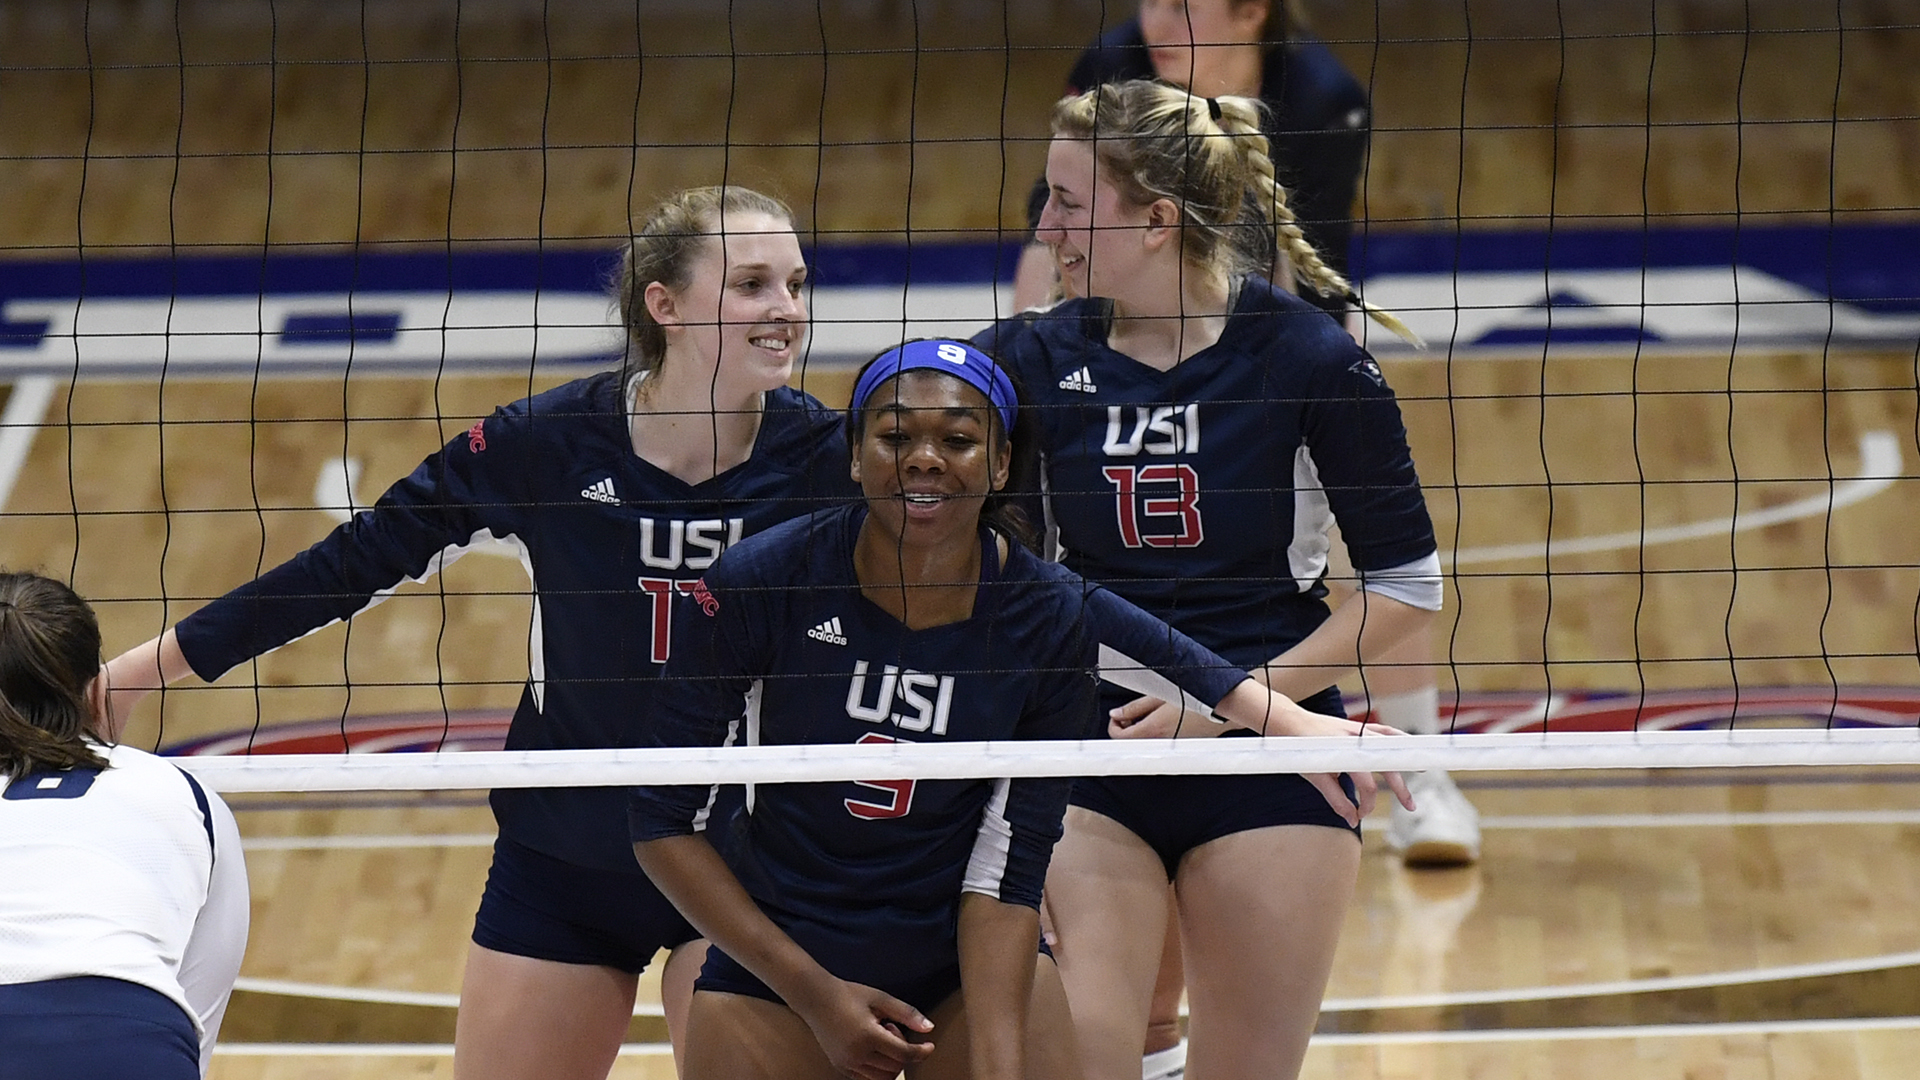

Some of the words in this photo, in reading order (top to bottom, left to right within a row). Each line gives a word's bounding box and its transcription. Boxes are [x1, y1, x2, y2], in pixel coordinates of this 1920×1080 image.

[1058, 380, 1097, 394] adidas
[1102, 403, 1199, 456] USI
[581, 489, 621, 507] adidas
[1102, 463, 1204, 548] 13
[639, 517, 744, 570] USI
[807, 628, 848, 646] adidas
[845, 659, 955, 736] USI
